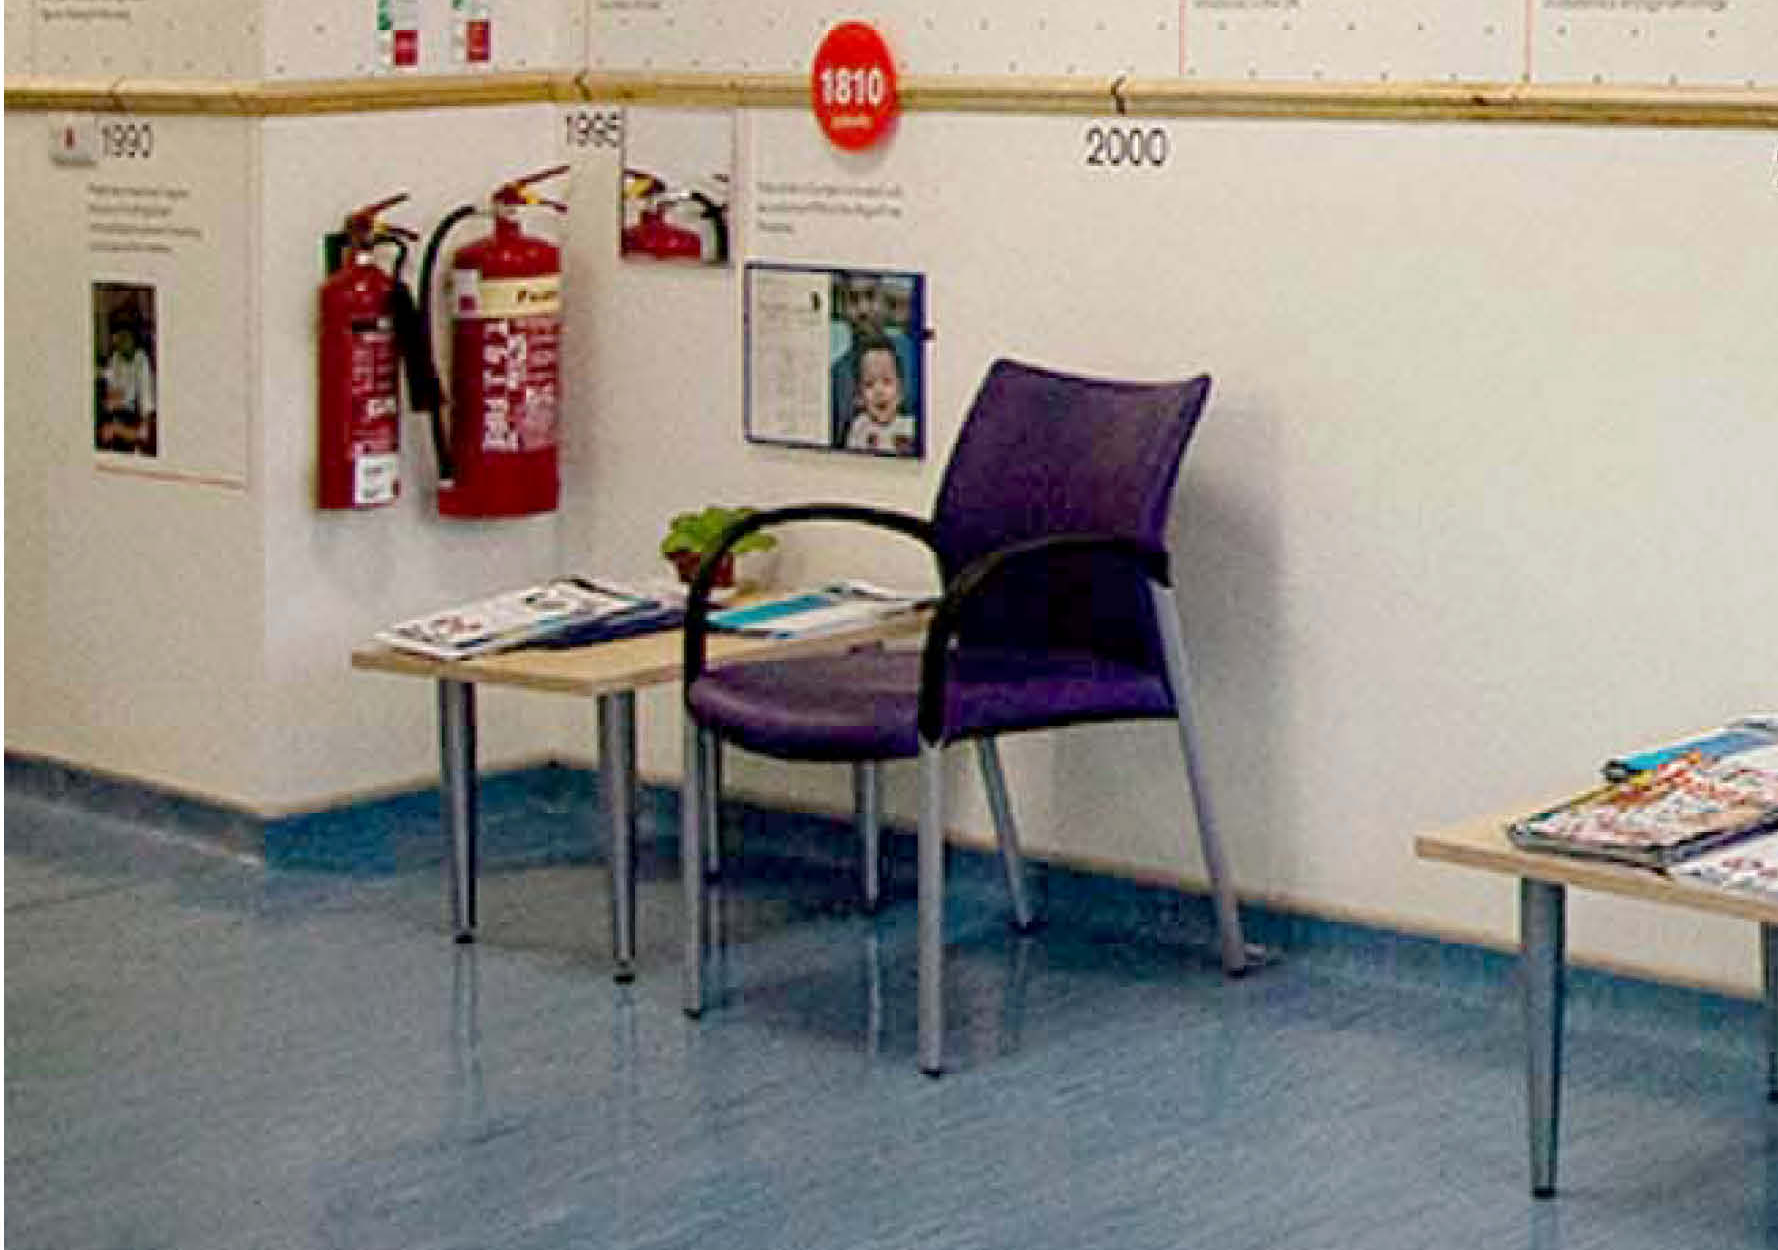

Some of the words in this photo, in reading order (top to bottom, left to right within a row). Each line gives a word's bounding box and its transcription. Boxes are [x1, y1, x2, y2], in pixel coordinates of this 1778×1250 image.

[820, 67, 883, 106] 1810
[102, 123, 155, 158] 1990
[1085, 127, 1168, 165] 2000
